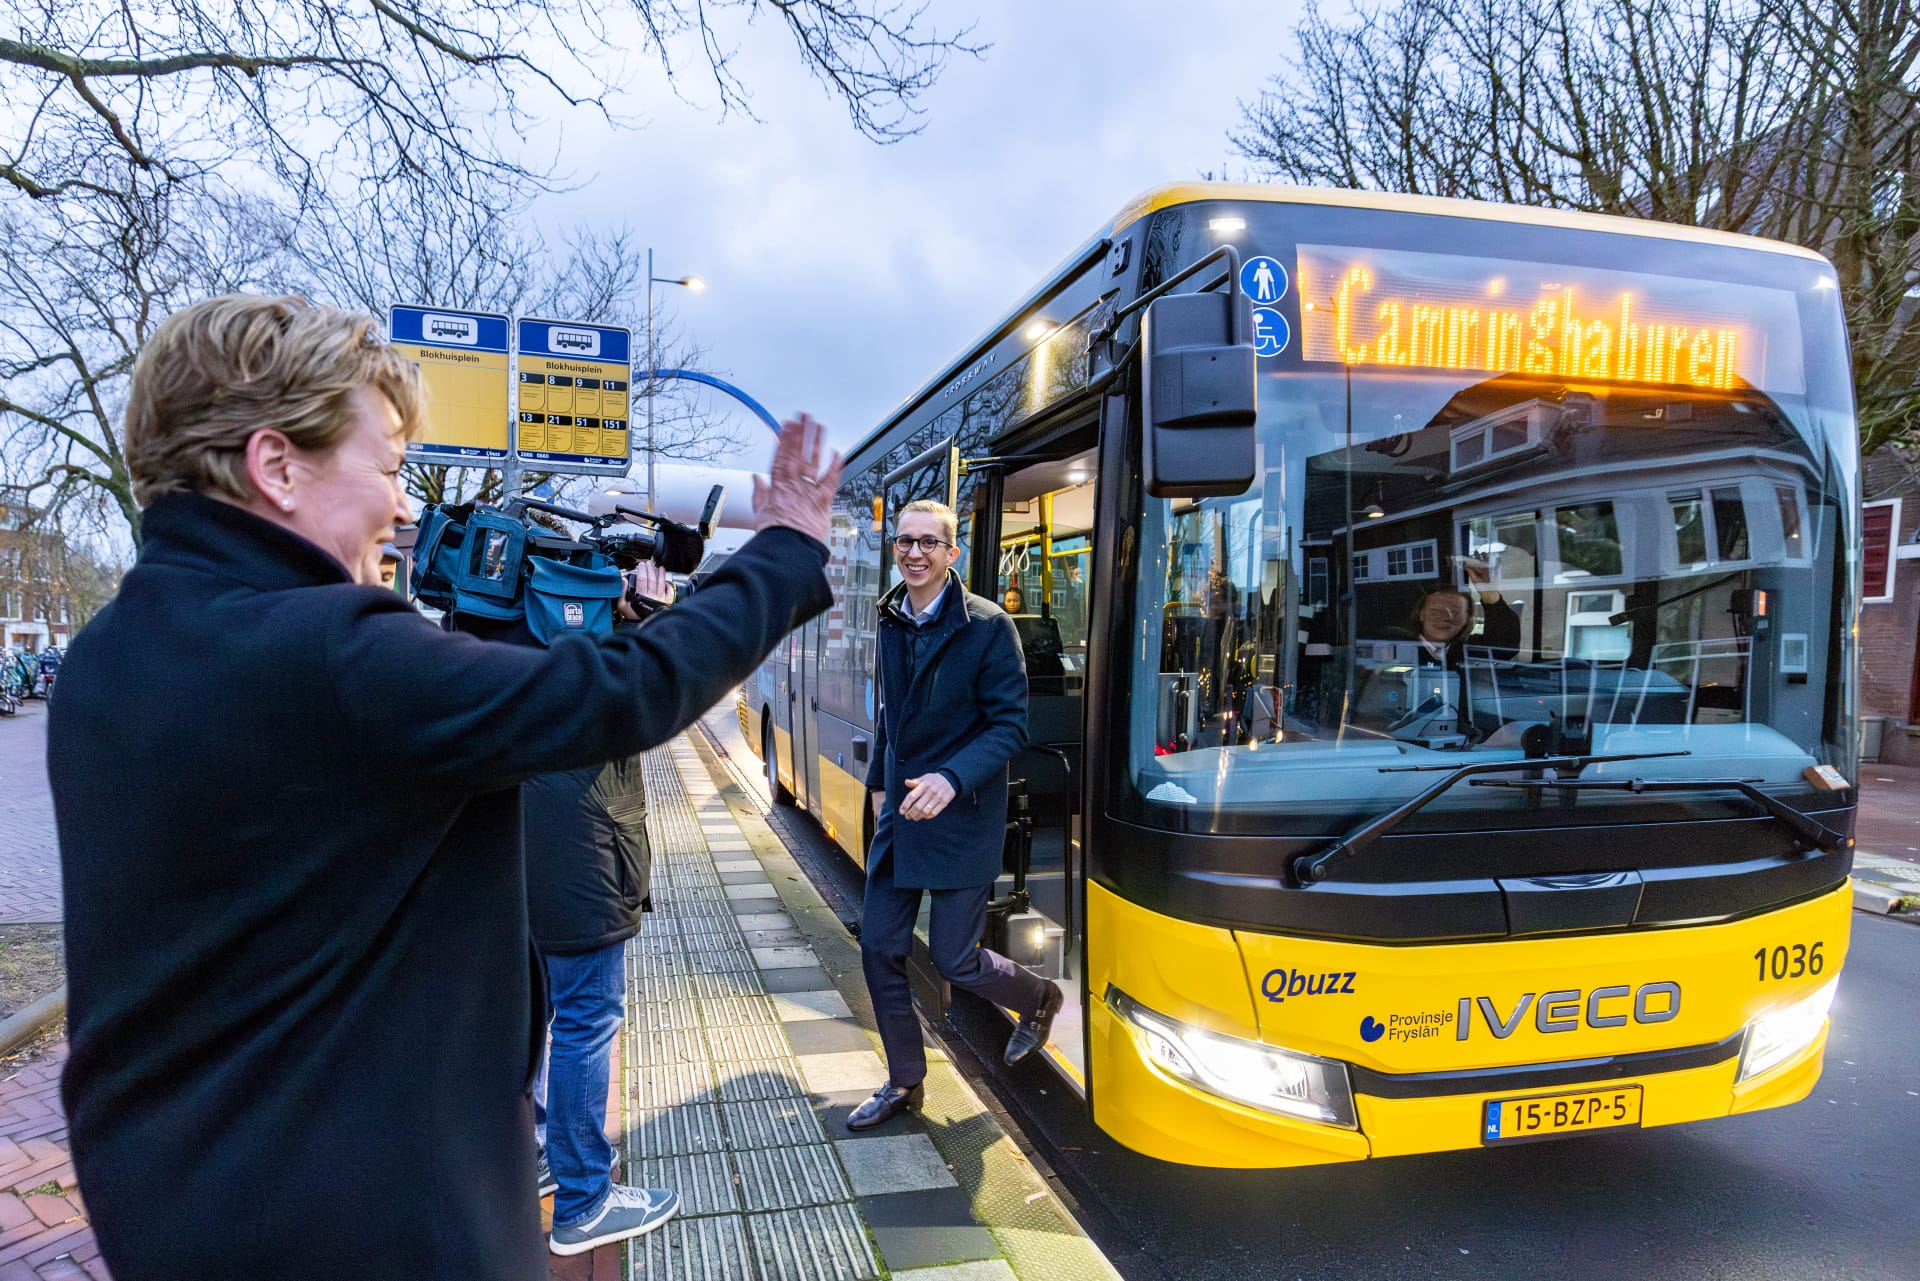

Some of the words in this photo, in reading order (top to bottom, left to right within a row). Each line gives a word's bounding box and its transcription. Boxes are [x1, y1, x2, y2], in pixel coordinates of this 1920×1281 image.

[1337, 267, 1737, 389] Camminghaburen
[419, 349, 480, 363] Blokhuisplein
[546, 361, 603, 374] Blokhuisplein
[944, 352, 996, 400] CROSSWAY
[520, 373, 527, 382] 3
[548, 375, 556, 385] 8
[576, 378, 583, 387] 9
[604, 381, 615, 390] 11
[521, 412, 533, 422] 13
[548, 415, 560, 425] 21
[576, 417, 588, 427] 51
[604, 420, 620, 430] 151
[1753, 941, 1824, 982] 1036
[1261, 968, 1357, 1003] Qbuzz
[1389, 1010, 1454, 1027] Provinsje
[1456, 981, 1682, 1042] IVECO
[1388, 1025, 1440, 1043] Fryslân
[1514, 1094, 1627, 1131] 15-BZP-5
[1487, 1124, 1499, 1133] NL
